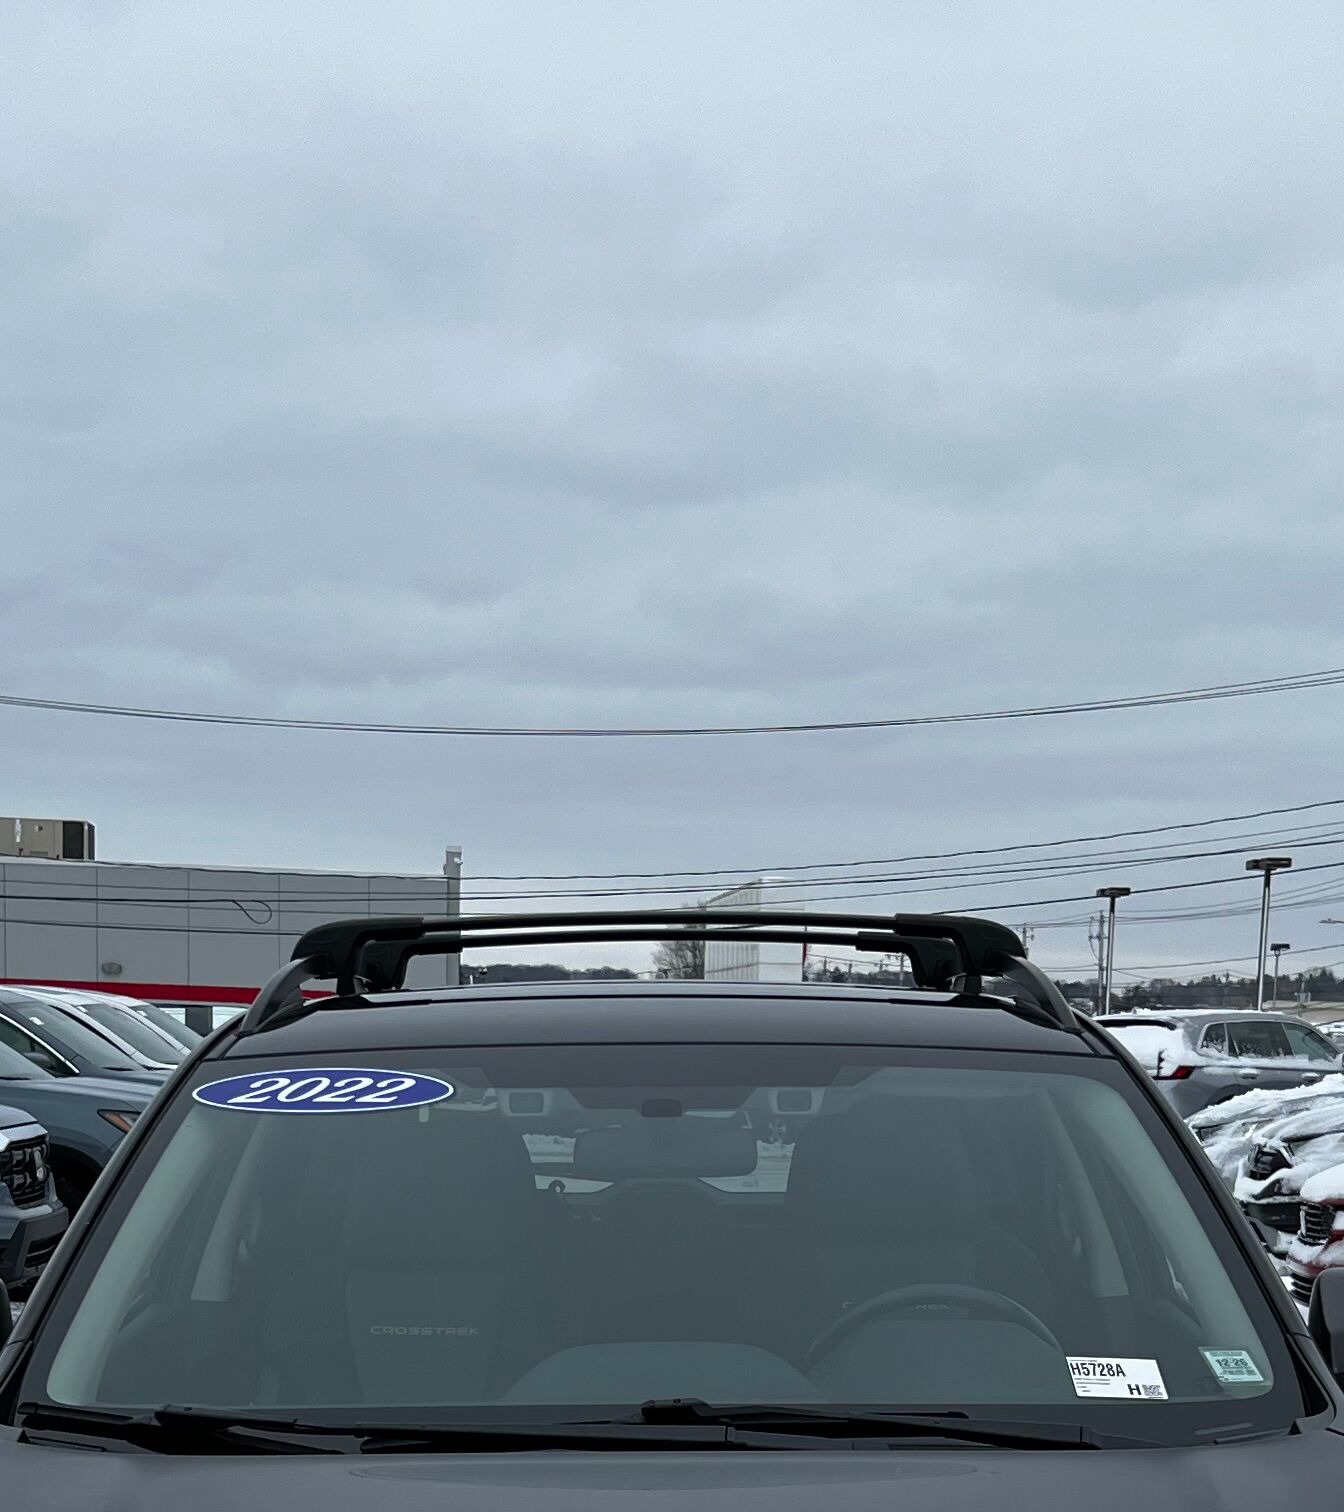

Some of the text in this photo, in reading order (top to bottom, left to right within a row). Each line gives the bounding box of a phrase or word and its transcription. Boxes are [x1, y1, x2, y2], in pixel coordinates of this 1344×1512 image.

[227, 1077, 416, 1103] 2022
[370, 1326, 480, 1336] CROSSTREK
[1069, 1362, 1126, 1377] H5728A
[1127, 1383, 1142, 1395] H
